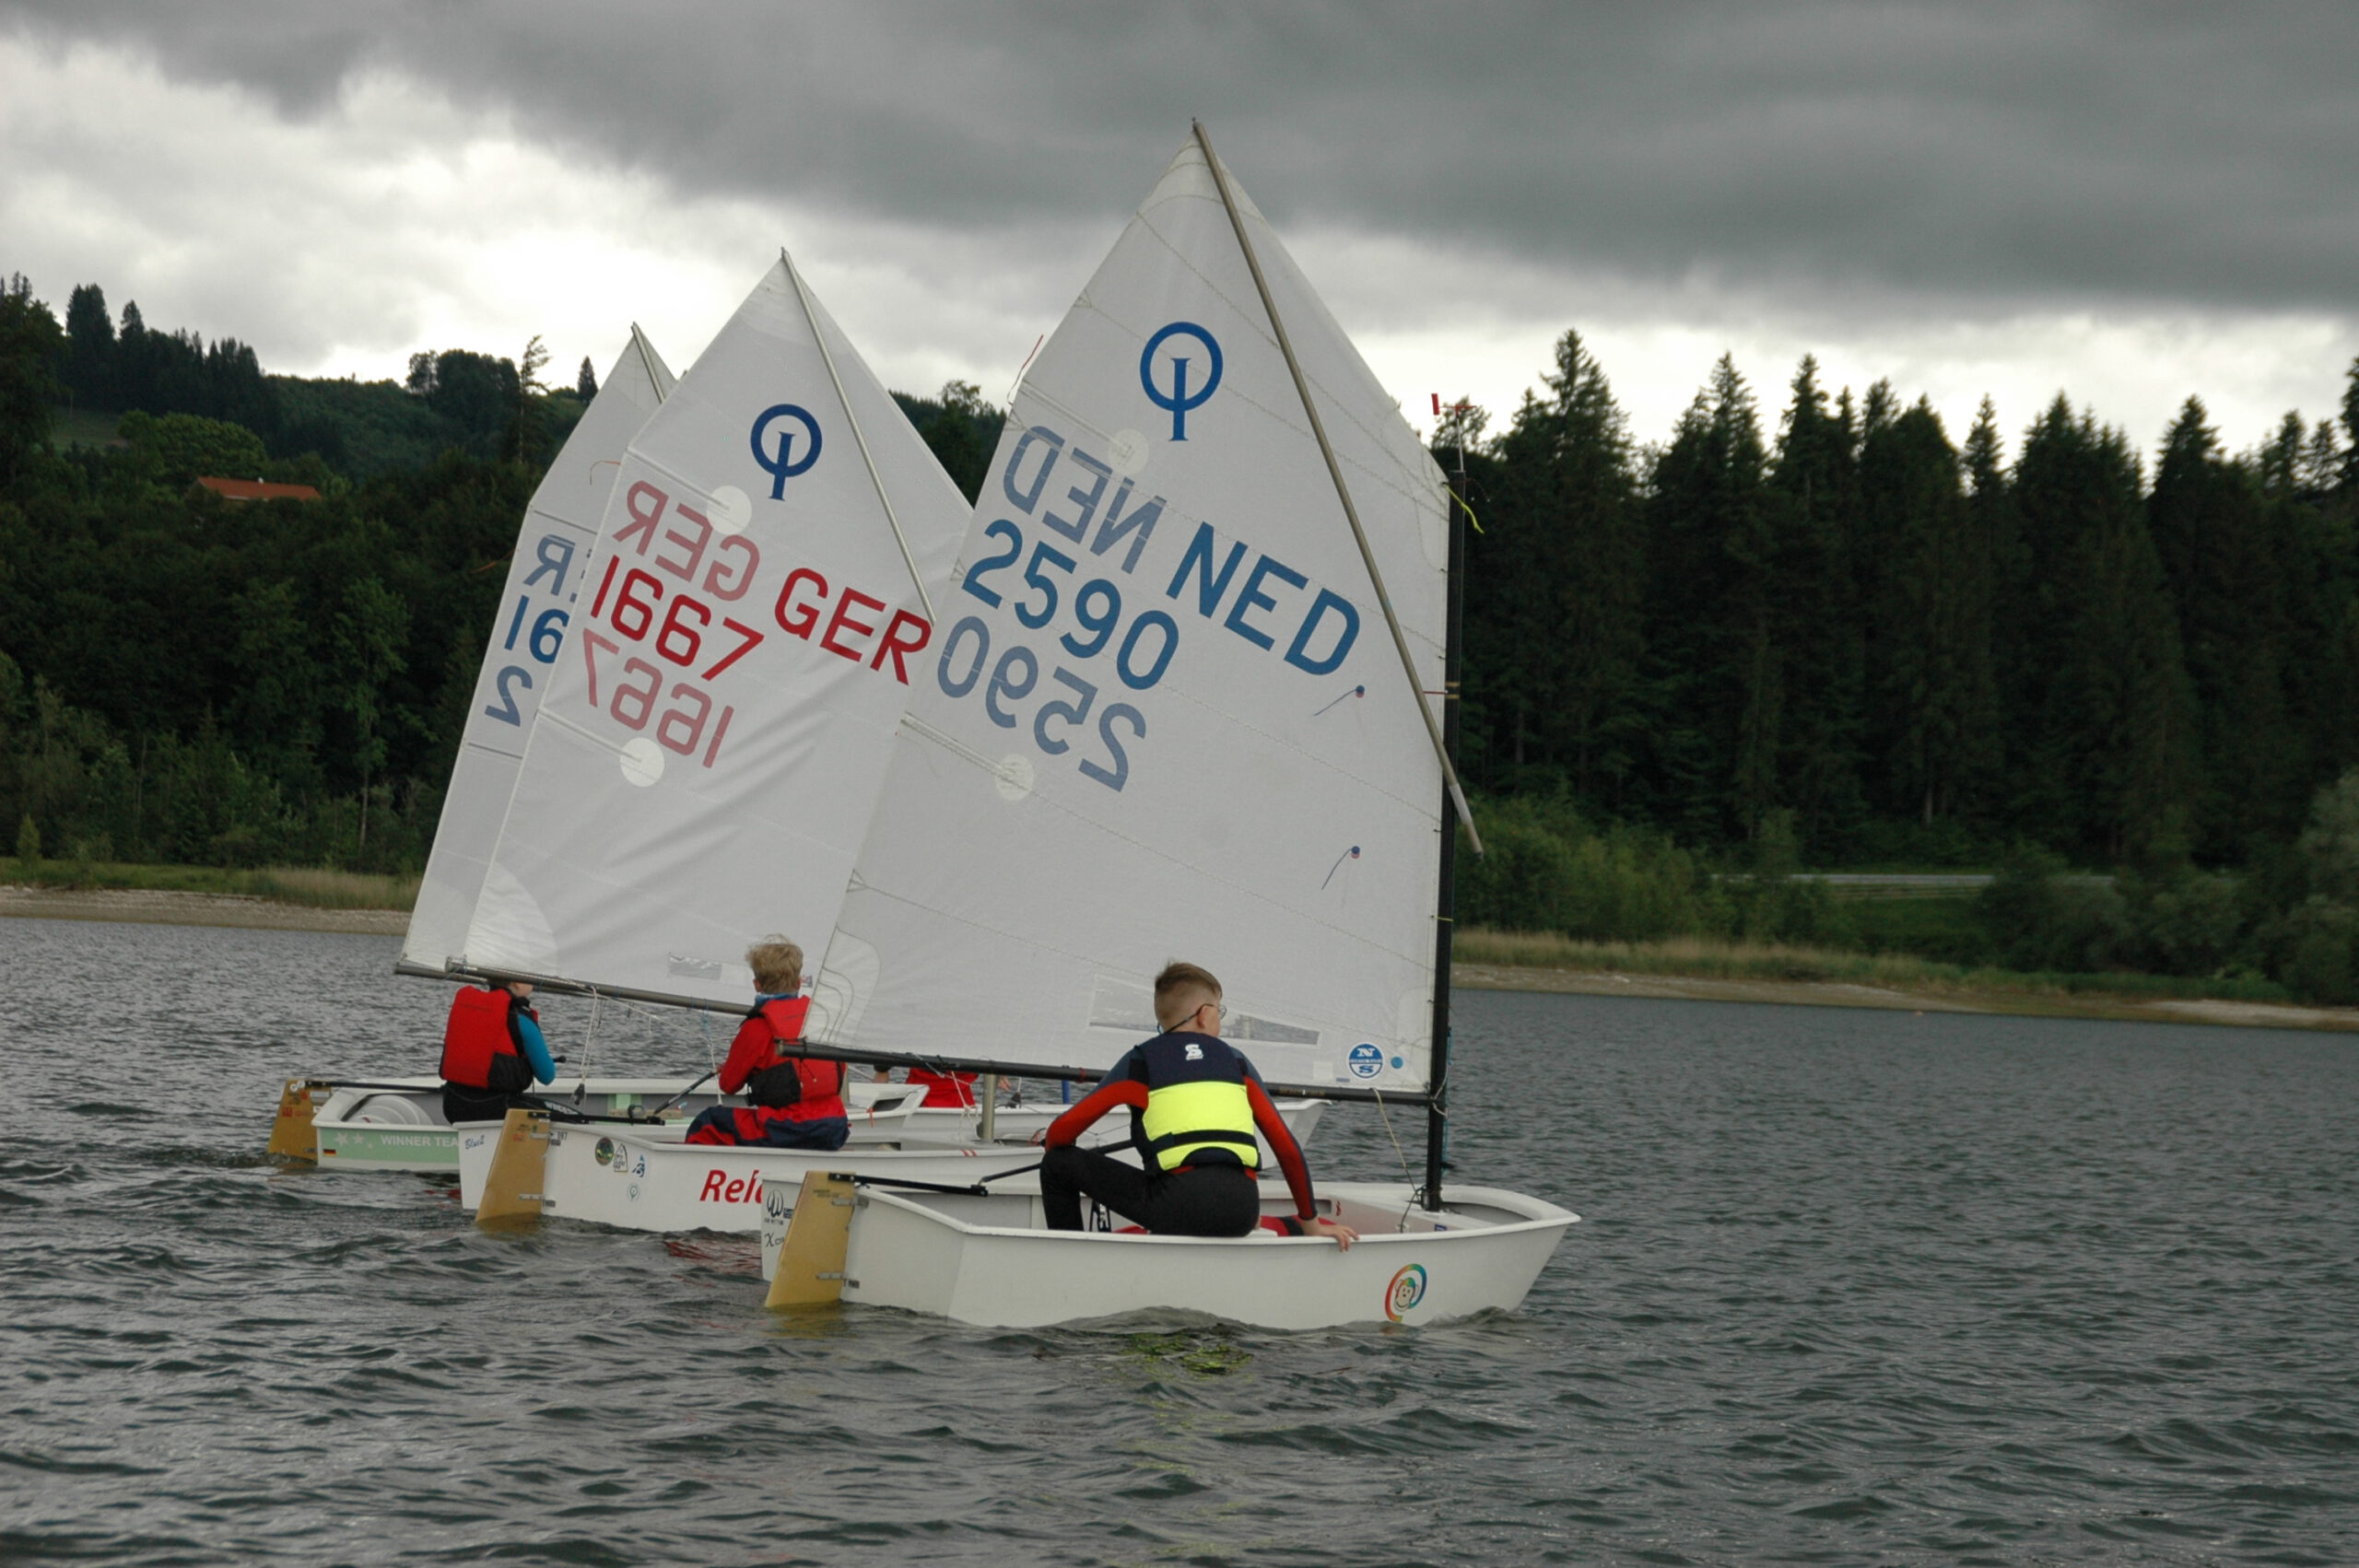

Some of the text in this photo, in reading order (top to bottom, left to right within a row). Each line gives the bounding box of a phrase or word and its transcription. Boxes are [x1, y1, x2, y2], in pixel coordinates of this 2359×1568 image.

[590, 554, 765, 682] 1667
[773, 567, 933, 686] GER
[961, 519, 1180, 691] 2590
[1165, 521, 1361, 676] NED
[380, 1134, 431, 1147] WINNER
